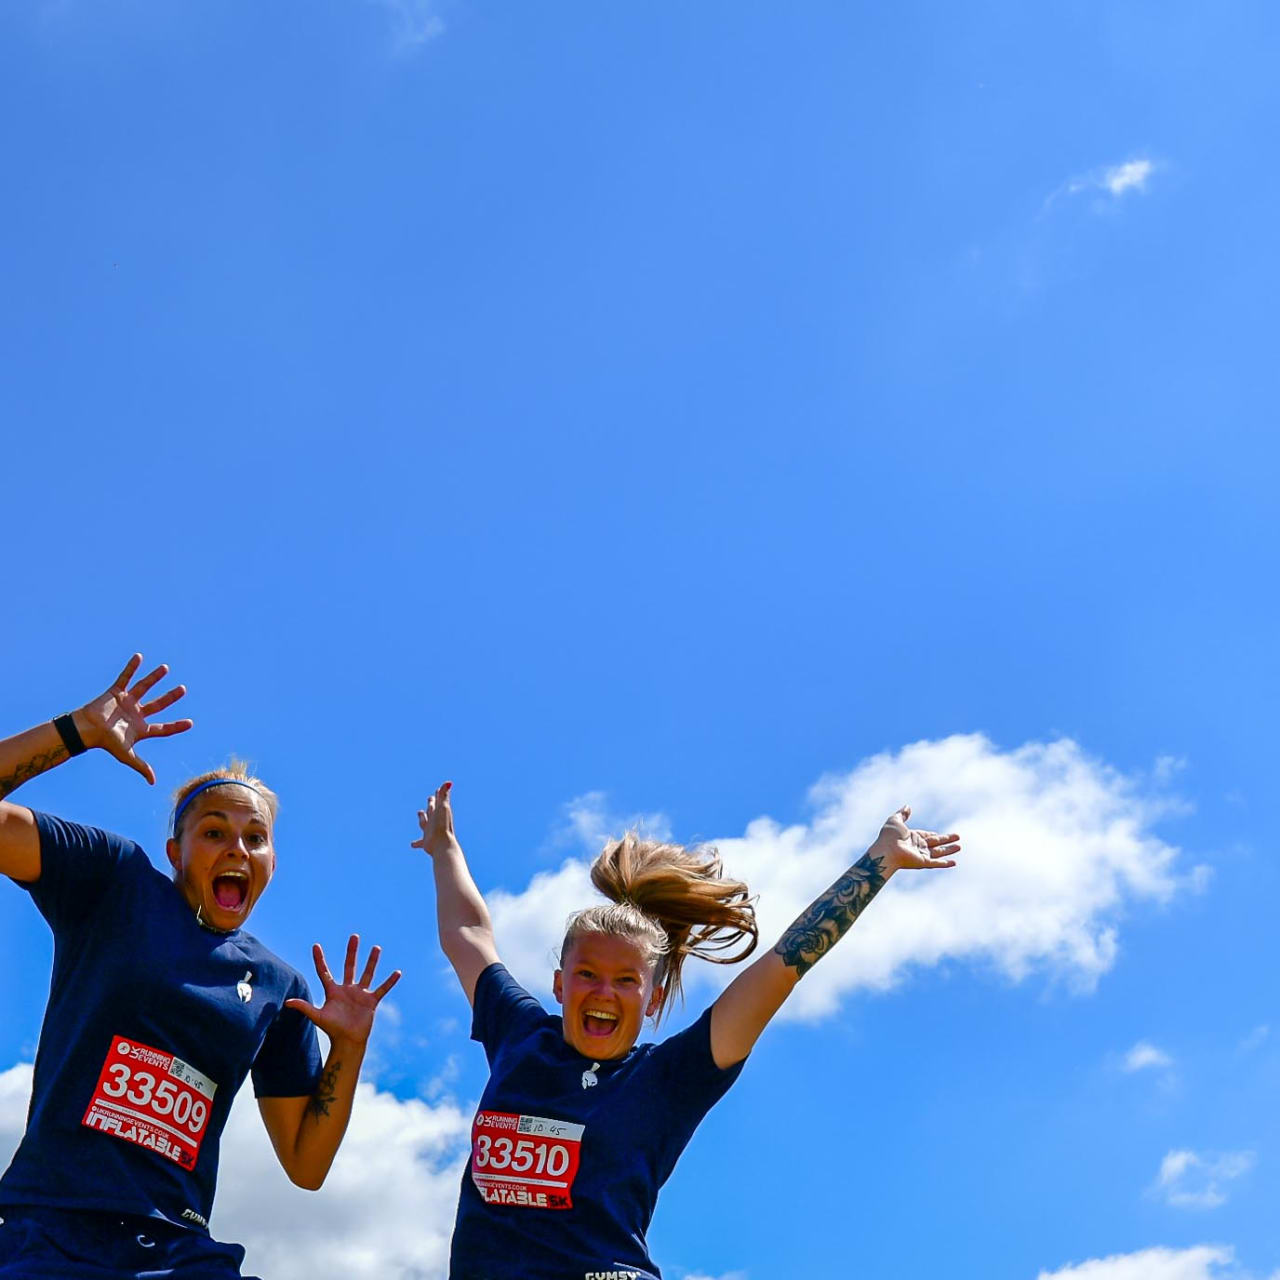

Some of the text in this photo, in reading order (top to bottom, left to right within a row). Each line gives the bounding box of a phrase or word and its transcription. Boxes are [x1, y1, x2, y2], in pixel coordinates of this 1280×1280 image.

[138, 1054, 170, 1071] EVENTS
[139, 1048, 171, 1064] RUNNING
[103, 1063, 207, 1133] 33509
[491, 1121, 517, 1131] EVENTS
[492, 1115, 518, 1124] RUNNING
[476, 1135, 570, 1177] 33510
